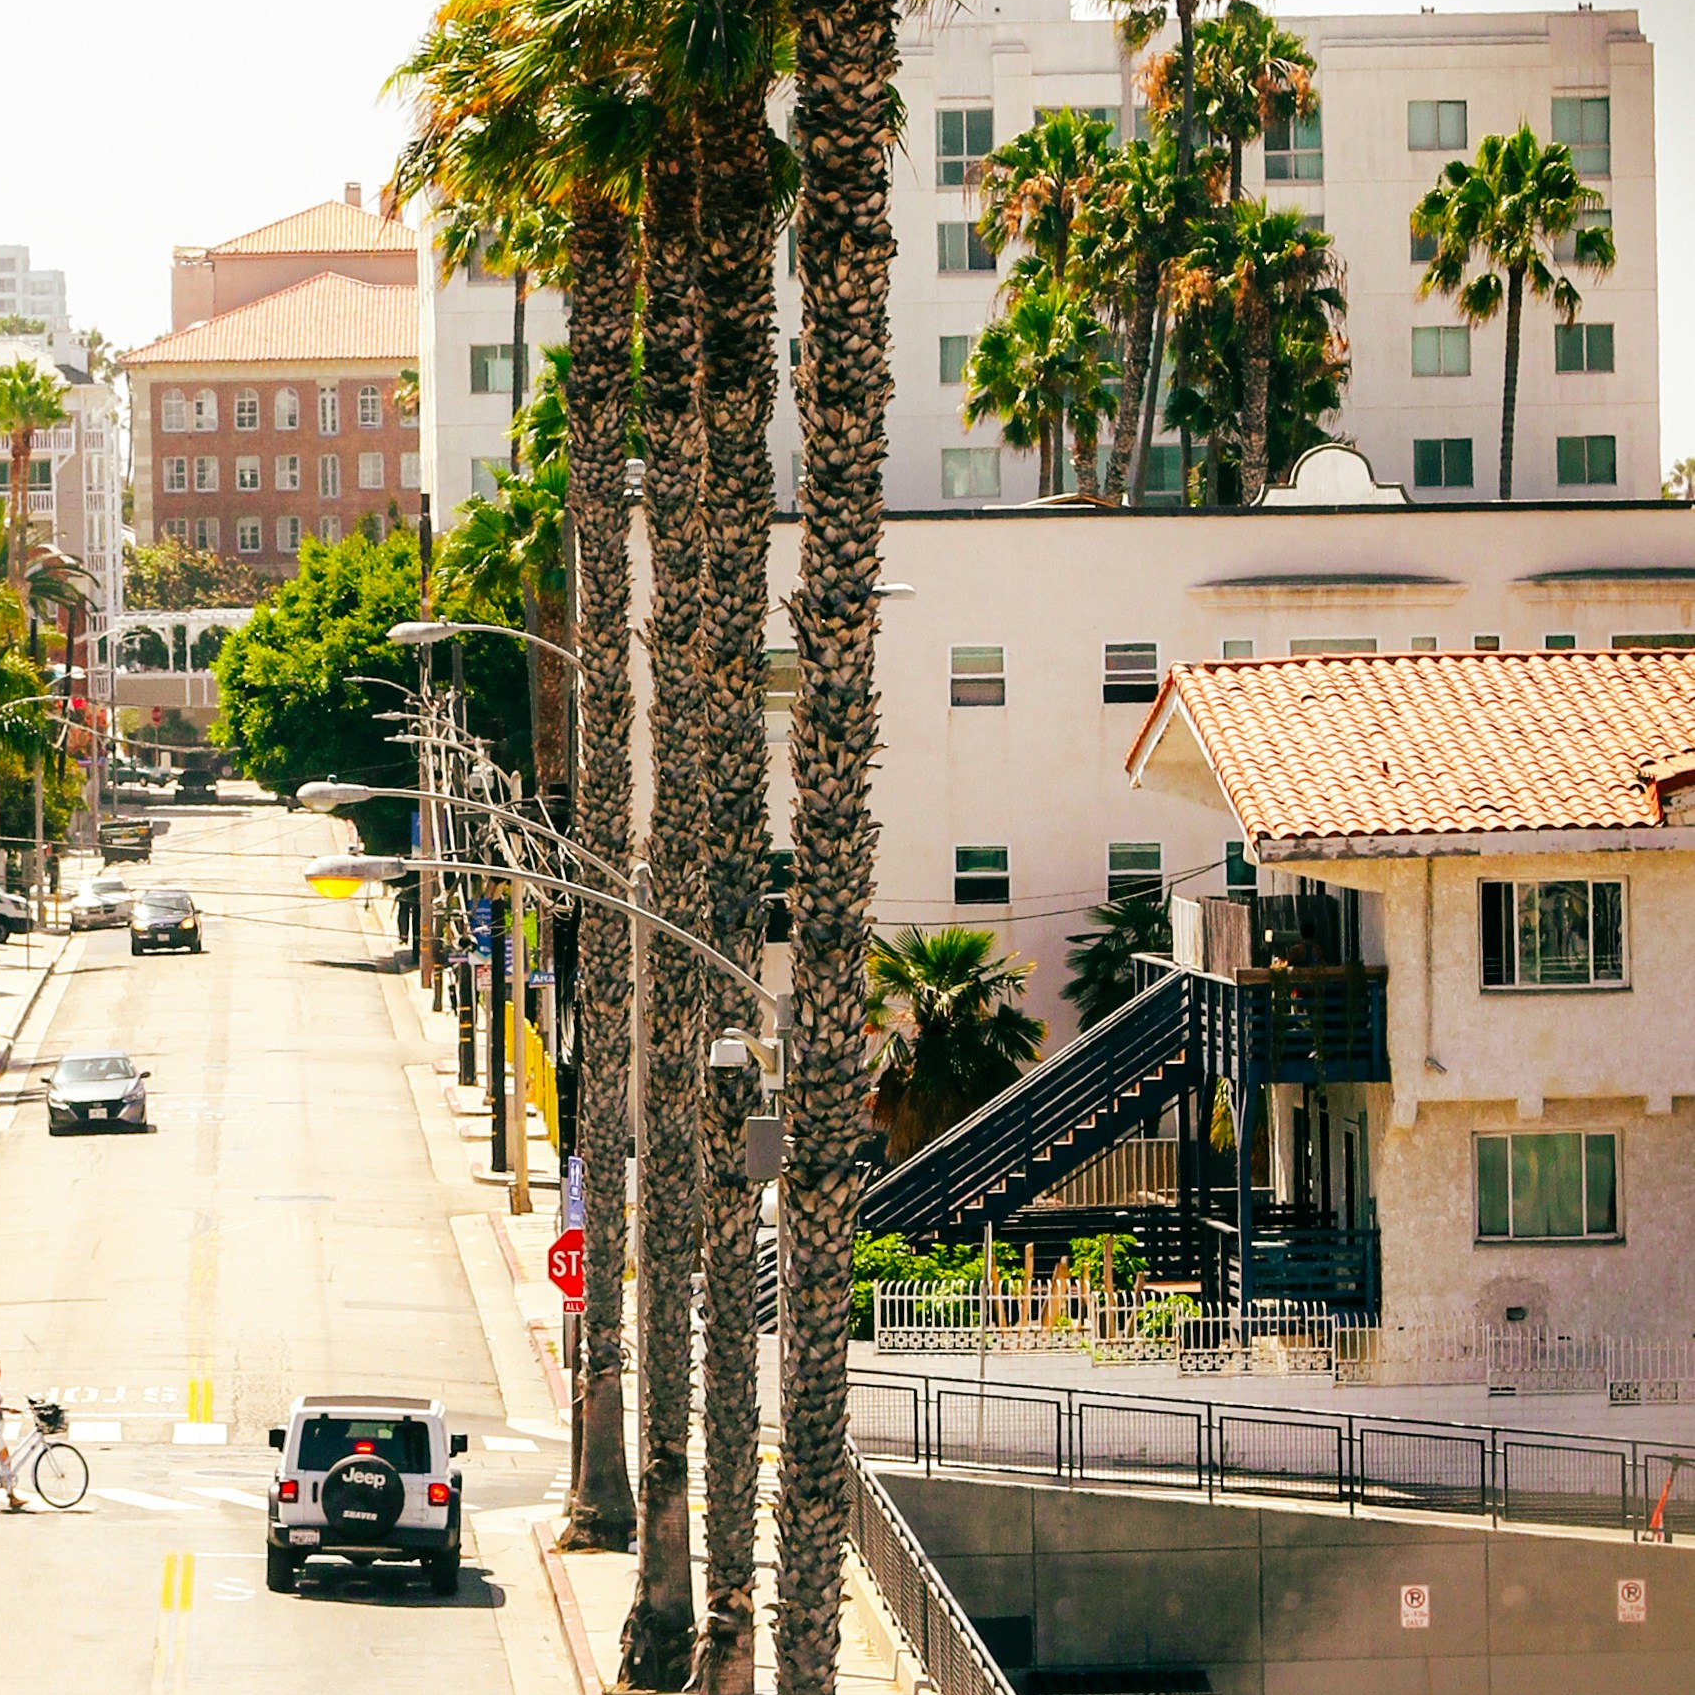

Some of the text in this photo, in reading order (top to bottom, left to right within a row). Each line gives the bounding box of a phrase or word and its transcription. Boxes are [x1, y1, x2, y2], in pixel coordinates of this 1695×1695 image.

[532, 974, 555, 984] Arca
[552, 1250, 581, 1278] ST
[565, 1302, 581, 1312] ALL
[341, 1466, 386, 1490] Jeep
[342, 1509, 378, 1522] SHAVER
